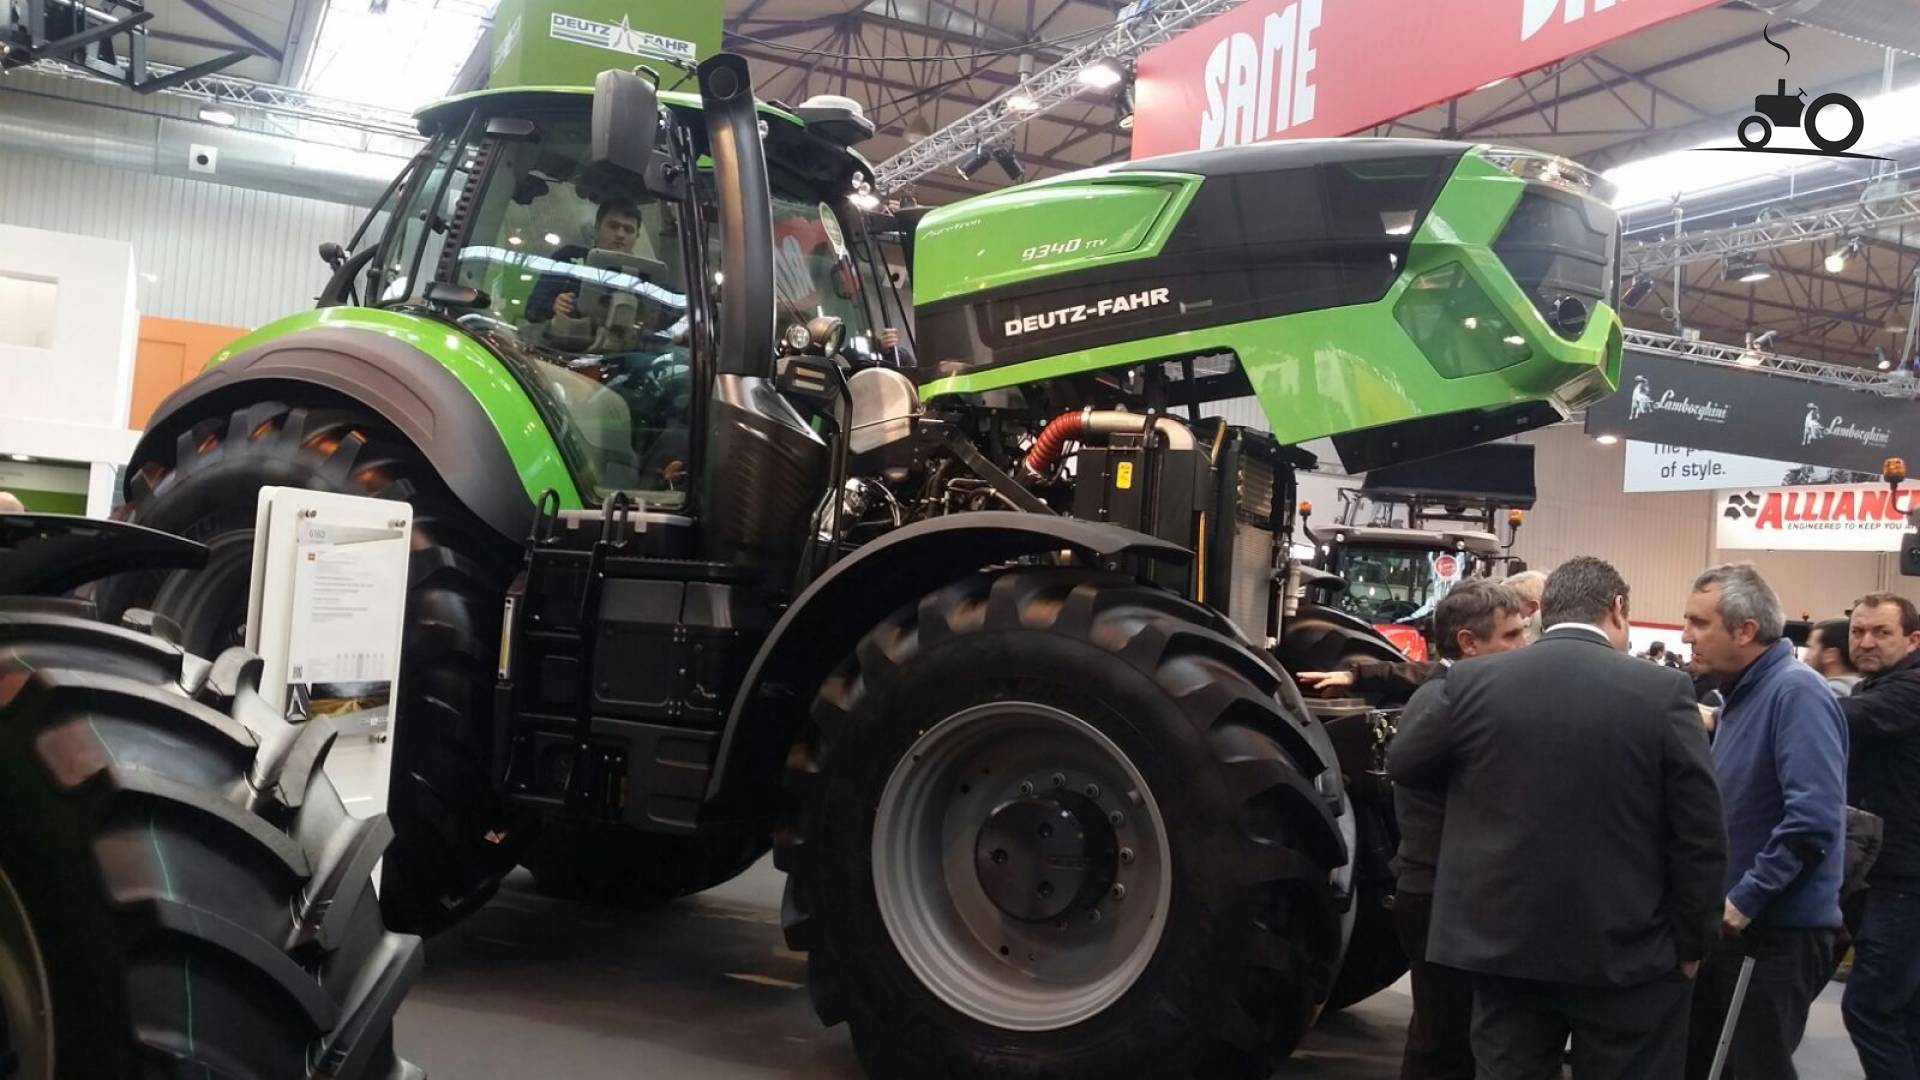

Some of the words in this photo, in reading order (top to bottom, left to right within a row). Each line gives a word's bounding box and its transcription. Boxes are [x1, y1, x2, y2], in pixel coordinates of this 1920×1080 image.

[552, 14, 611, 37] DEUTZ
[643, 34, 690, 53] FAHR
[1201, 0, 1322, 151] SAME
[1021, 237, 1082, 262] 9340
[1085, 238, 1108, 250] TTV
[1004, 287, 1170, 337] DEUTZ-FAHR
[1654, 389, 1730, 421] Lamborghini
[1824, 415, 1890, 446] Lamborghini
[1660, 460, 1677, 478] of
[1682, 459, 1726, 481] style.
[1787, 522, 1842, 530] ENGINEERED
[1844, 522, 1856, 530] TO
[1858, 522, 1882, 530] KEEP
[1884, 522, 1903, 530] YOU
